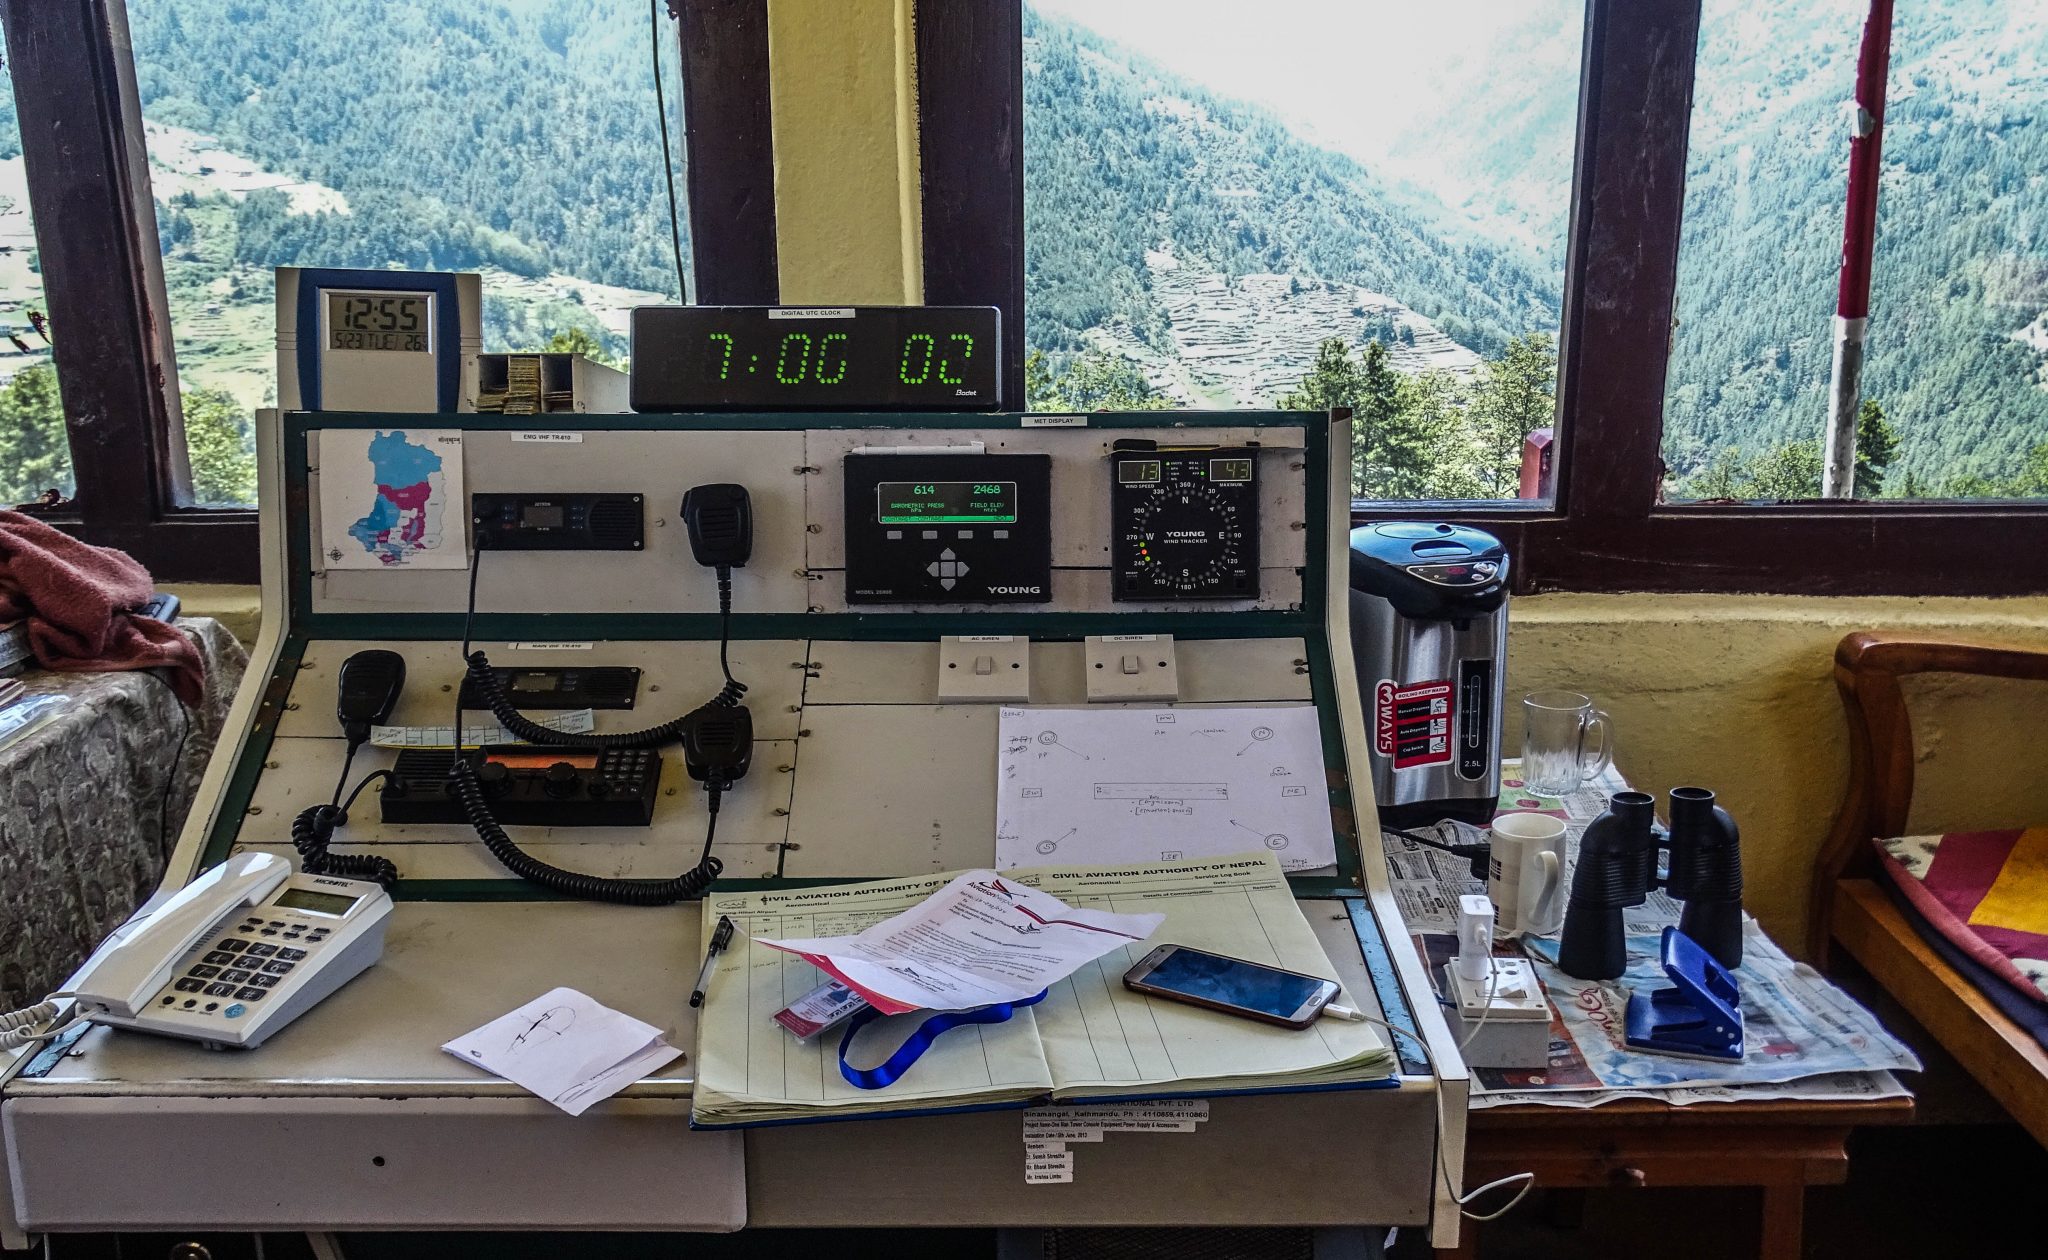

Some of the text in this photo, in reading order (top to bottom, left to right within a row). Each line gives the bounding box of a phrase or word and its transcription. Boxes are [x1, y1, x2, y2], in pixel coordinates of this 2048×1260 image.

[344, 299, 418, 330] 12:55
[955, 388, 977, 397] Bodet
[913, 484, 935, 495] 614
[973, 484, 1001, 495] 2468
[1182, 496, 1189, 504] N
[1145, 533, 1155, 541] W
[1218, 531, 1225, 540] E
[1182, 568, 1189, 577] S
[987, 586, 1041, 594] YOUNG
[1398, 691, 1418, 699] BOILING
[1380, 705, 1393, 751] WAYS
[1052, 872, 1083, 880] CIVIL
[1085, 870, 1140, 879] AVIATION
[1142, 866, 1212, 876] AUTHORITY
[1229, 859, 1267, 868] NEPAL
[761, 894, 790, 902] CIVIL
[794, 890, 850, 900] AVIATION
[853, 884, 924, 896] AUTHORITY
[924, 880, 941, 888] OF
[785, 901, 830, 909] Aeronautical
[1137, 1122, 1151, 1130] Supply
